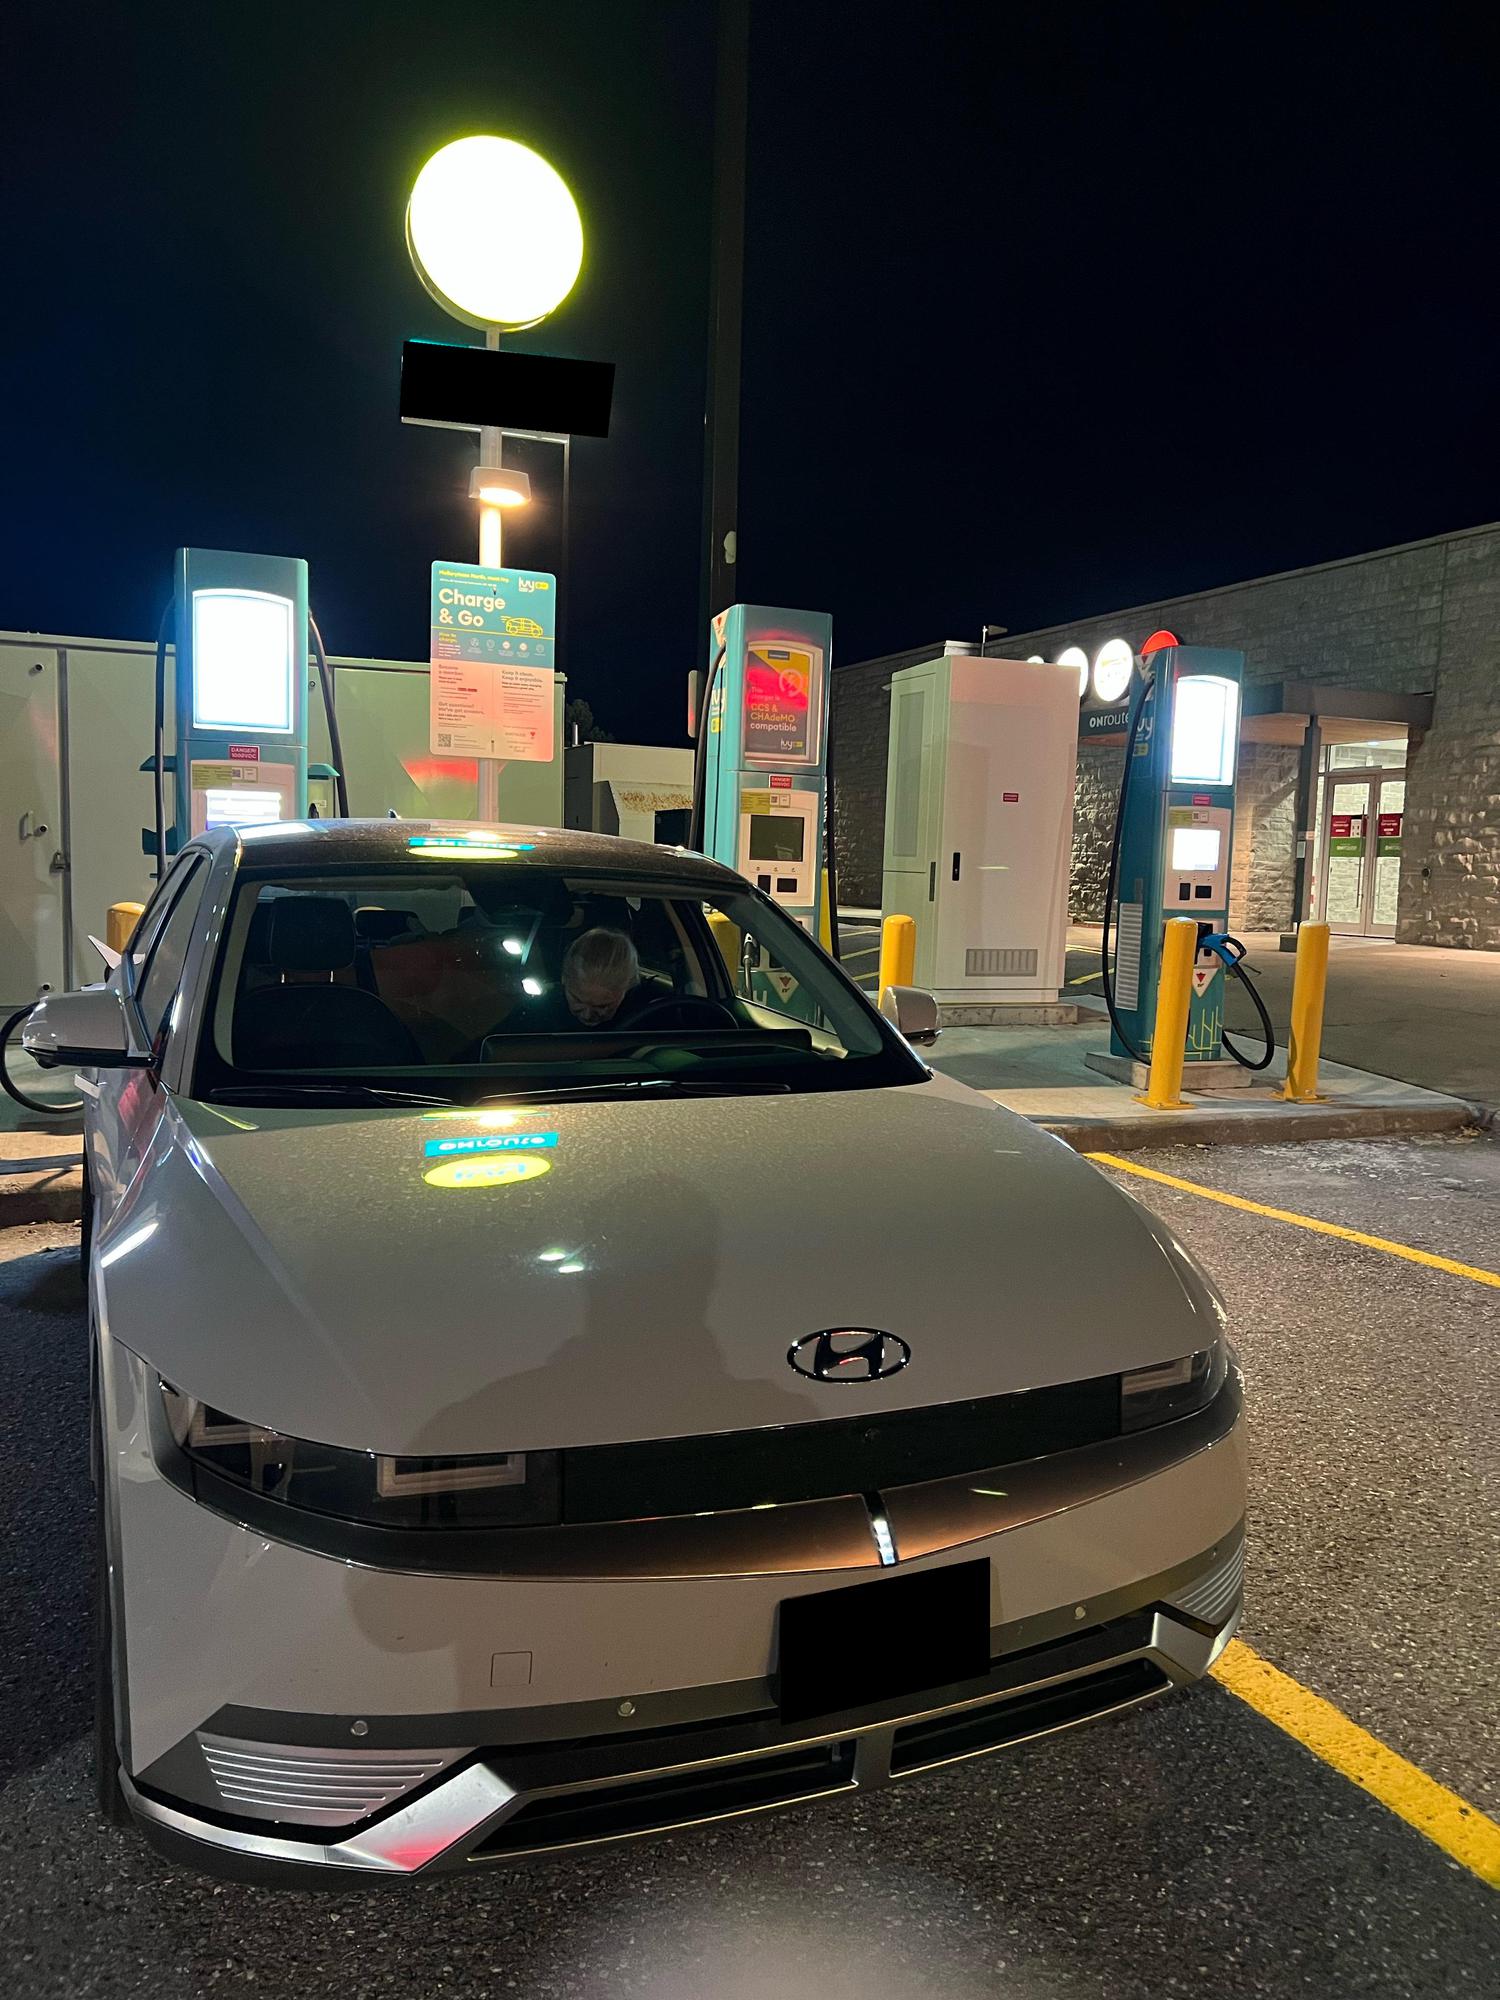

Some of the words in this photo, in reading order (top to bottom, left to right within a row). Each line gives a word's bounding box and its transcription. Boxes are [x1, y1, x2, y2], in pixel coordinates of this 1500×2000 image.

[439, 588, 506, 613] Charge
[439, 608, 454, 625] &
[457, 609, 485, 627] Go
[751, 703, 770, 712] CCS
[750, 712, 796, 723] CHAdeMO
[750, 722, 797, 732] compatible
